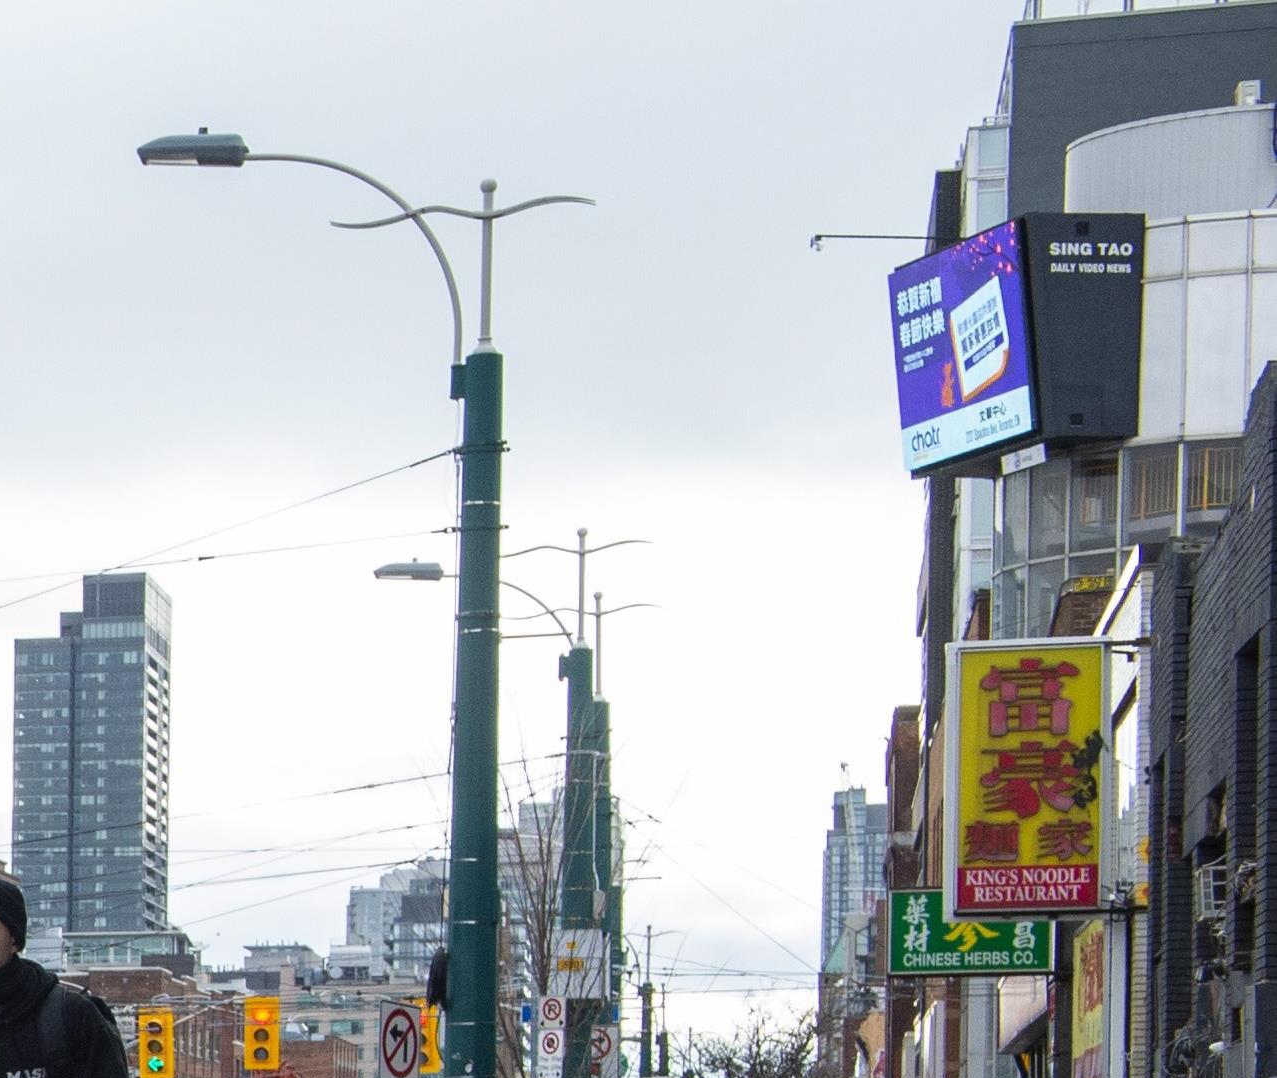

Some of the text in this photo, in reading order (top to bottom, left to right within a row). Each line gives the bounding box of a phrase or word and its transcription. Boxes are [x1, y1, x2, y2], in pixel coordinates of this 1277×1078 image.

[1049, 242, 1133, 256] SING TAO
[1050, 262, 1132, 274] DAILY VIDEO NEWS
[965, 867, 1091, 886] KING'S NOODLE
[973, 884, 1082, 902] RESTAURANT
[903, 949, 1039, 967] CHINESE HERBS CO.
